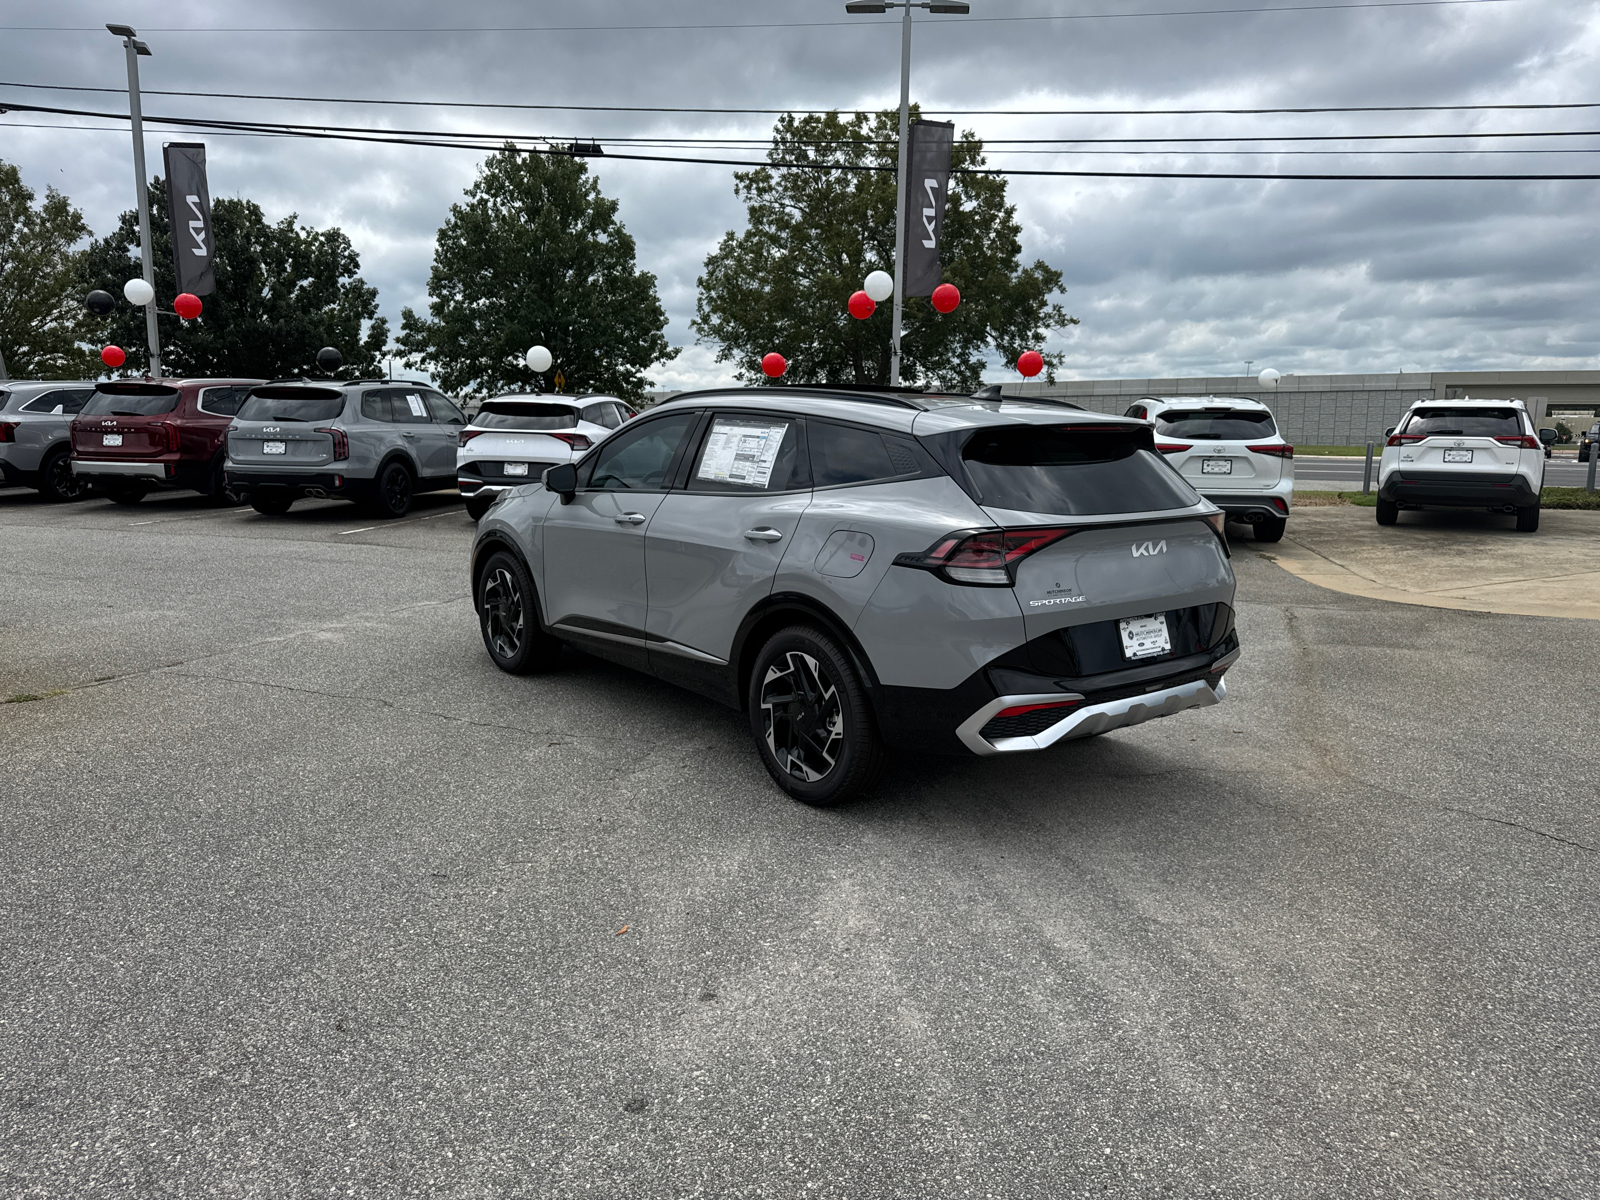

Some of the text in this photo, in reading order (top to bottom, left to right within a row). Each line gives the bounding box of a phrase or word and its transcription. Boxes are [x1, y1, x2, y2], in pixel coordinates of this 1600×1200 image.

[185, 194, 208, 257] KIA
[917, 178, 938, 249] KIA
[1131, 540, 1167, 558] KIA
[1029, 595, 1086, 607] SPORTAGE
